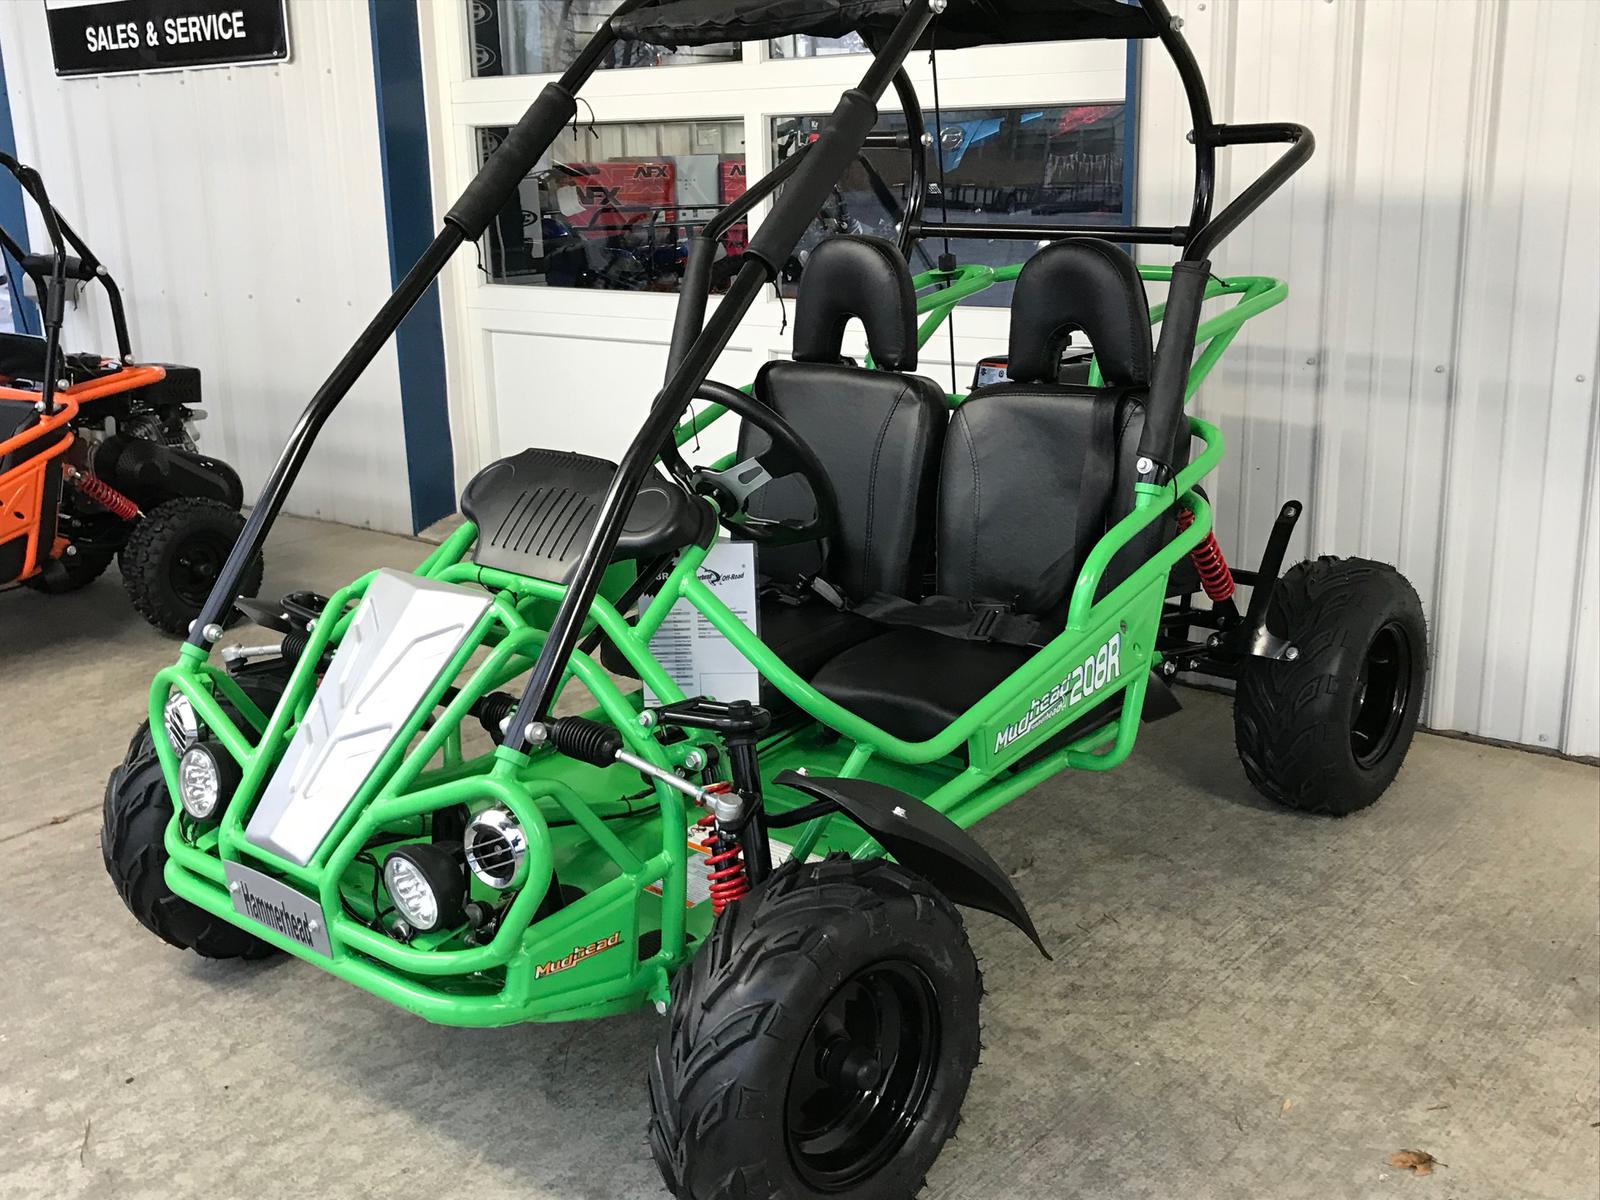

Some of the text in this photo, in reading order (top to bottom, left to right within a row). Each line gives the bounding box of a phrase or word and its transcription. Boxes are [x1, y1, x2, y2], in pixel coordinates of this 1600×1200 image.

[86, 11, 247, 52] SALES & SERVICE
[633, 166, 669, 178] AFX
[993, 672, 1072, 755] Mudhead
[1068, 632, 1121, 707] 208R
[240, 880, 314, 947] Hammerhead
[534, 931, 621, 980] Mudhead
